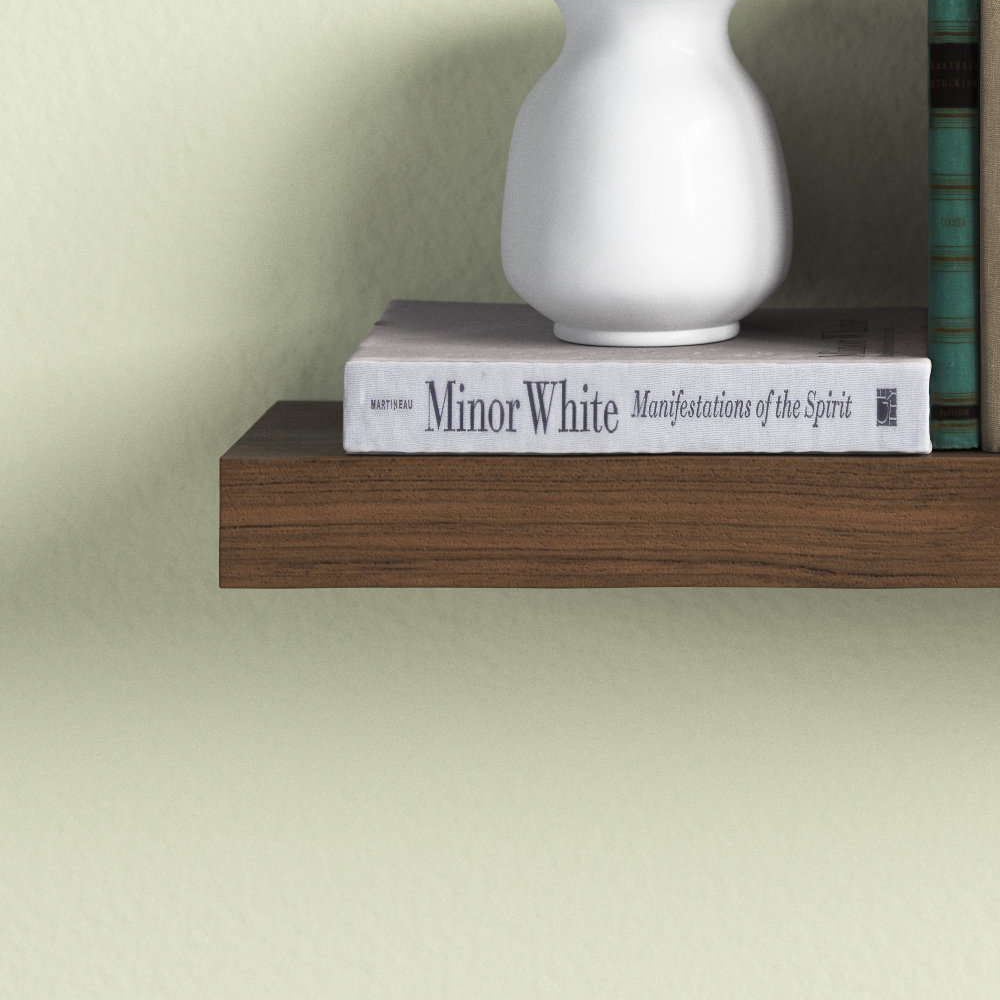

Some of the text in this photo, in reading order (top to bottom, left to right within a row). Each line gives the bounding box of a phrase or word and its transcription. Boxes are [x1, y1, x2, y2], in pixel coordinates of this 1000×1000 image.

[370, 398, 413, 411] MARTINEAU
[631, 389, 752, 427] Manifestations
[755, 389, 775, 428] of
[776, 389, 801, 419] the
[804, 389, 853, 428] Spirit
